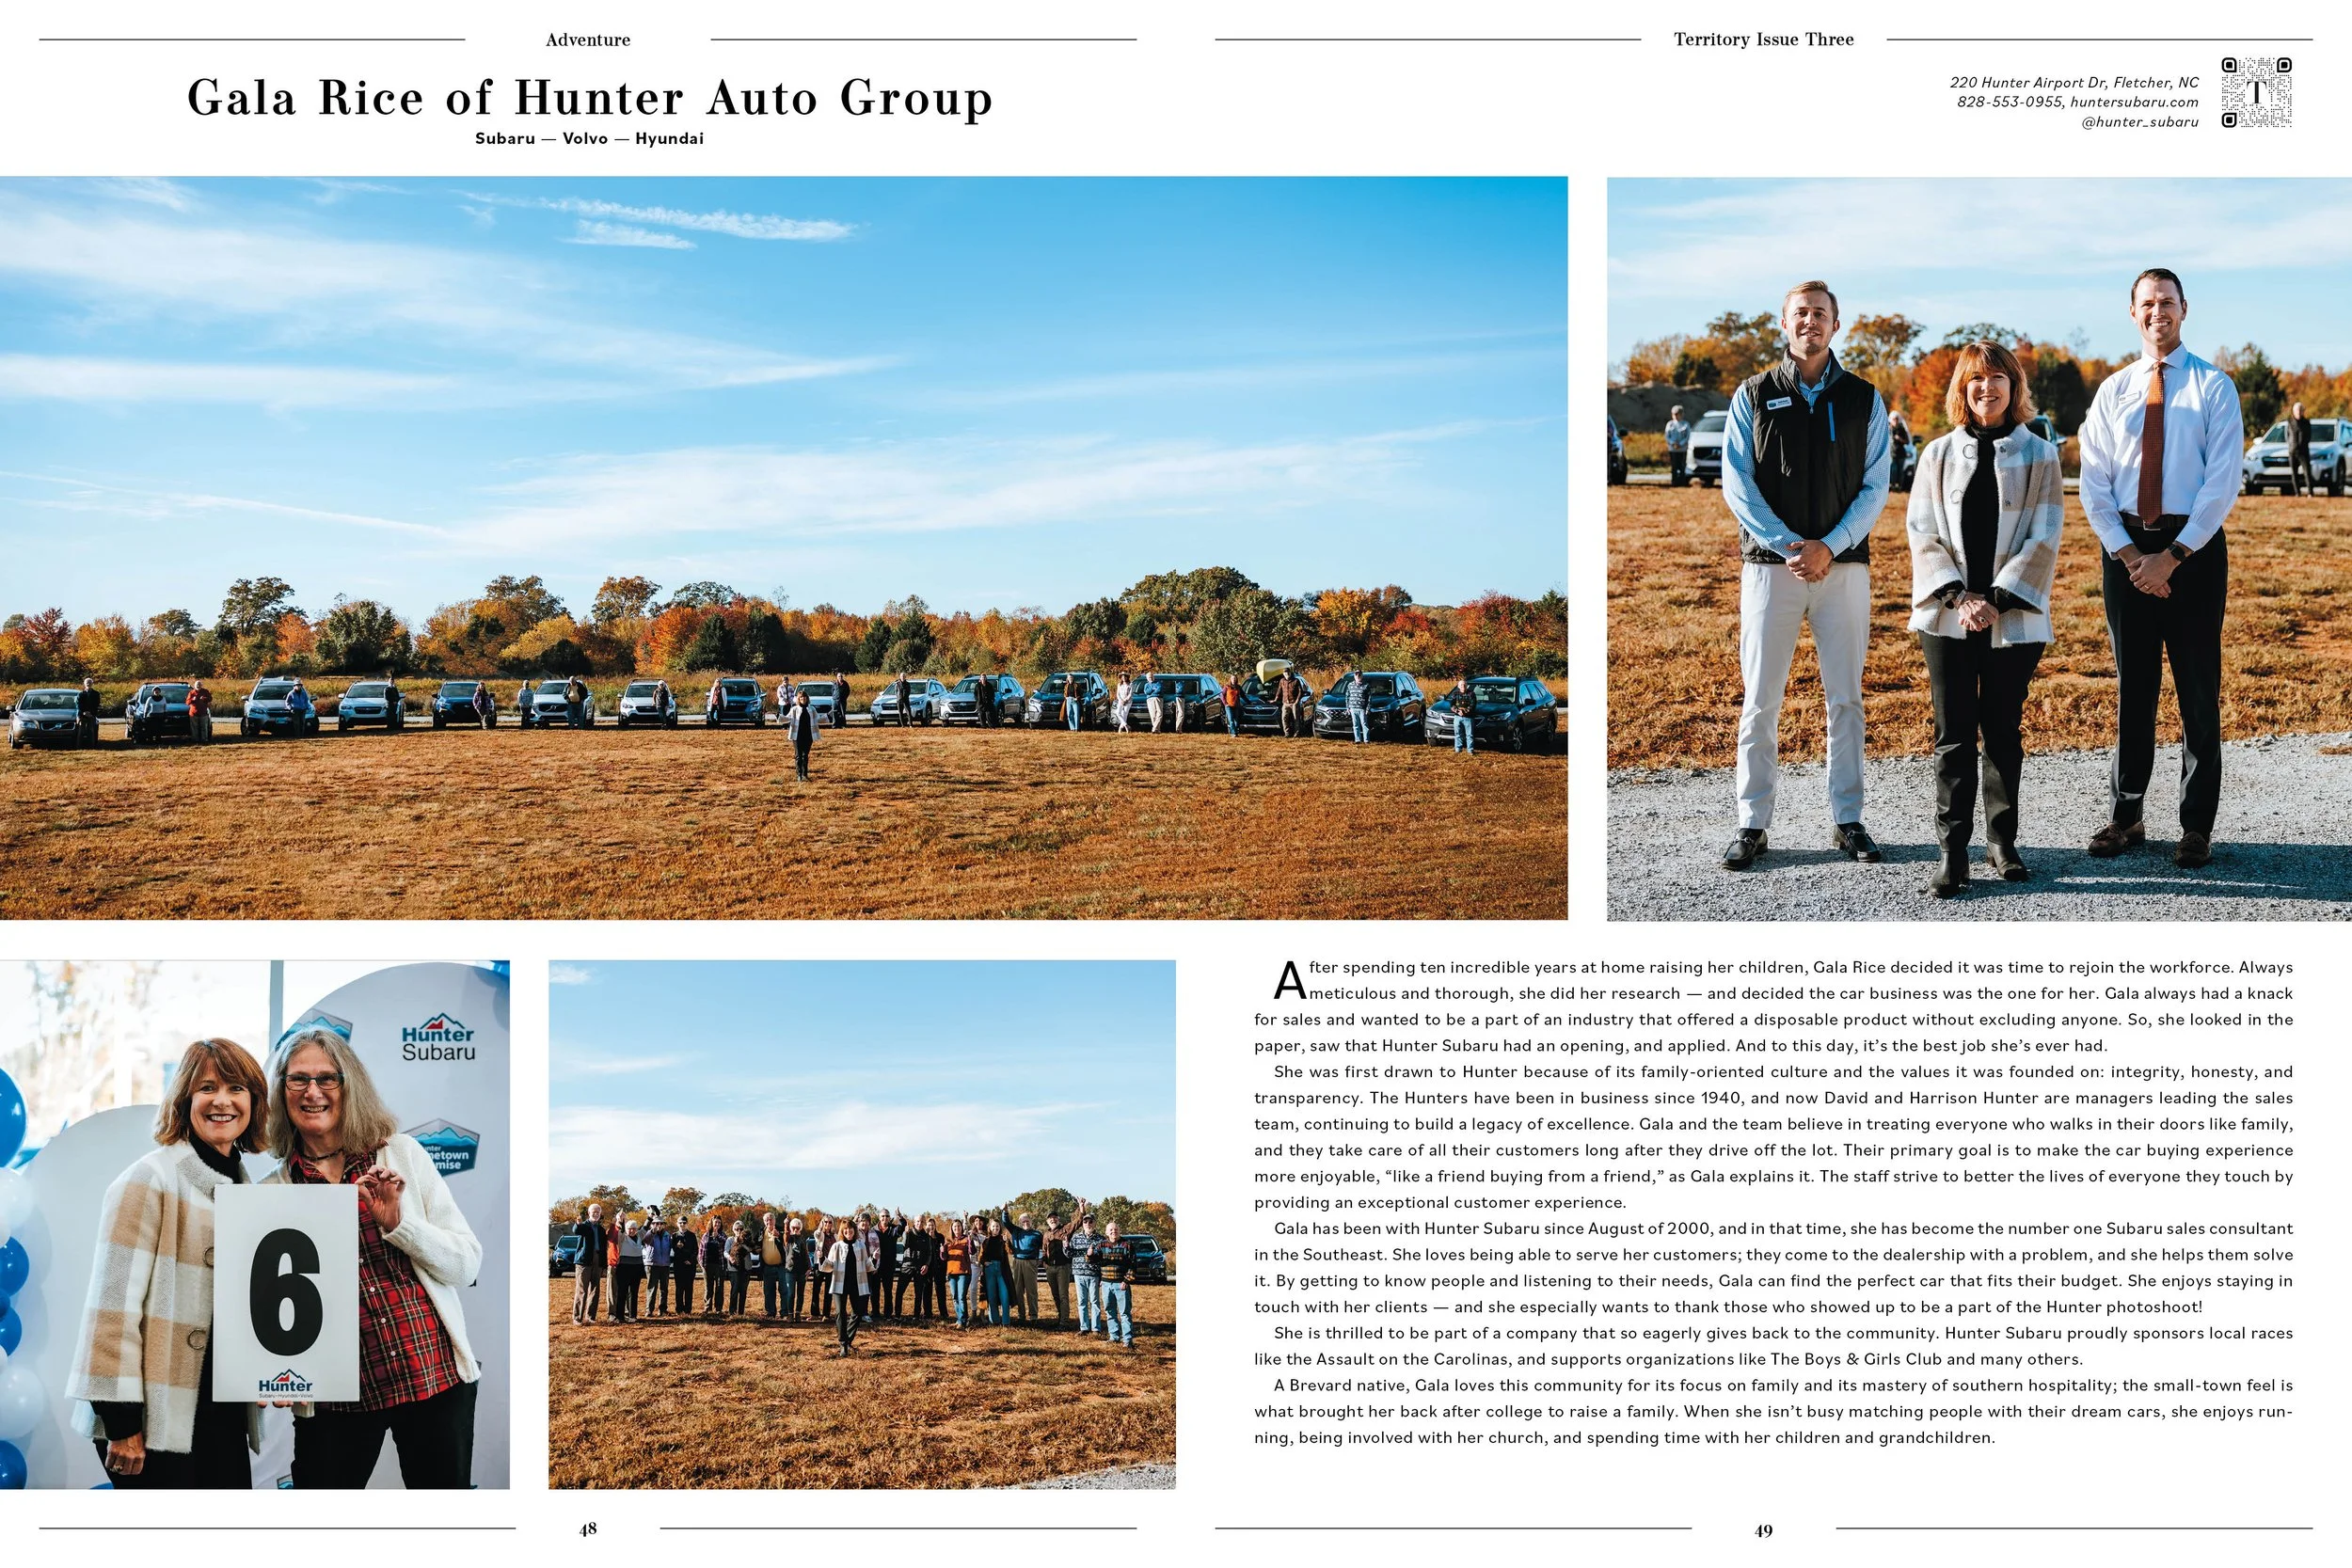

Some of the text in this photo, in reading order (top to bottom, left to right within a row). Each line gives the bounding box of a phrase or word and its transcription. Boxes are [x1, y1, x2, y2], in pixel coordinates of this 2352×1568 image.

[545, 32, 631, 47] Adventure
[1674, 31, 1854, 50] Territory Issue Three
[1949, 76, 2200, 91] 220 Hunter Airport Dr, Fletcher, NC
[2246, 80, 2267, 104] T
[187, 77, 992, 126] Gala Rice of Hunter Auto Group
[1957, 95, 2199, 110] 828-553-0955, huntersubaru.com
[2081, 115, 2200, 131] @hunter_subaru
[475, 132, 704, 149] Subaru Volvo Hyundai
[1343, 960, 1416, 977] spending
[1420, 961, 1446, 974] ten
[1451, 960, 1531, 974] incredible
[1534, 964, 1577, 977] years
[1581, 961, 1597, 974] at
[1601, 960, 1645, 974] home
[1649, 960, 1703, 977] raising
[1708, 960, 1735, 974] her
[1739, 960, 1809, 976] children,
[1813, 960, 1848, 974] Gala
[1852, 960, 1886, 974] Rice
[1890, 960, 1953, 974] decided
[1958, 960, 1970, 974] it
[1973, 964, 2003, 974] was
[2008, 960, 2044, 974] time
[2047, 961, 2064, 974] to
[2069, 960, 2114, 977] rejoin
[2118, 960, 2145, 974] the
[2149, 960, 2234, 974] workforce.
[2238, 960, 2294, 977] Always
[402, 1026, 475, 1042] Hunter
[402, 1043, 476, 1061] Subaru
[1274, 1065, 2293, 1082] She was first drawn to Hunter because of its family-oriented culture and the values it was founded on: integrity, honesty, and
[1254, 1143, 2294, 1161] and they take care of all their customers long after they drive off the lot. Their primary goal is to make the car buying experience
[1254, 1196, 1627, 1212] providing an exceptional customer experience.
[1254, 1274, 2293, 1291] it. By getting to know people and listening to their needs, Gala can find the perfect car that fits their budget. She enjoys staying in
[249, 1227, 324, 1356] 6
[1254, 1352, 2083, 1370] like the Assault on the Carolinas, and supports organizations like The Boys & Girls Club and many others.
[259, 1380, 313, 1392] Hunter
[579, 1521, 597, 1538] 48
[1754, 1524, 1773, 1539] 49
